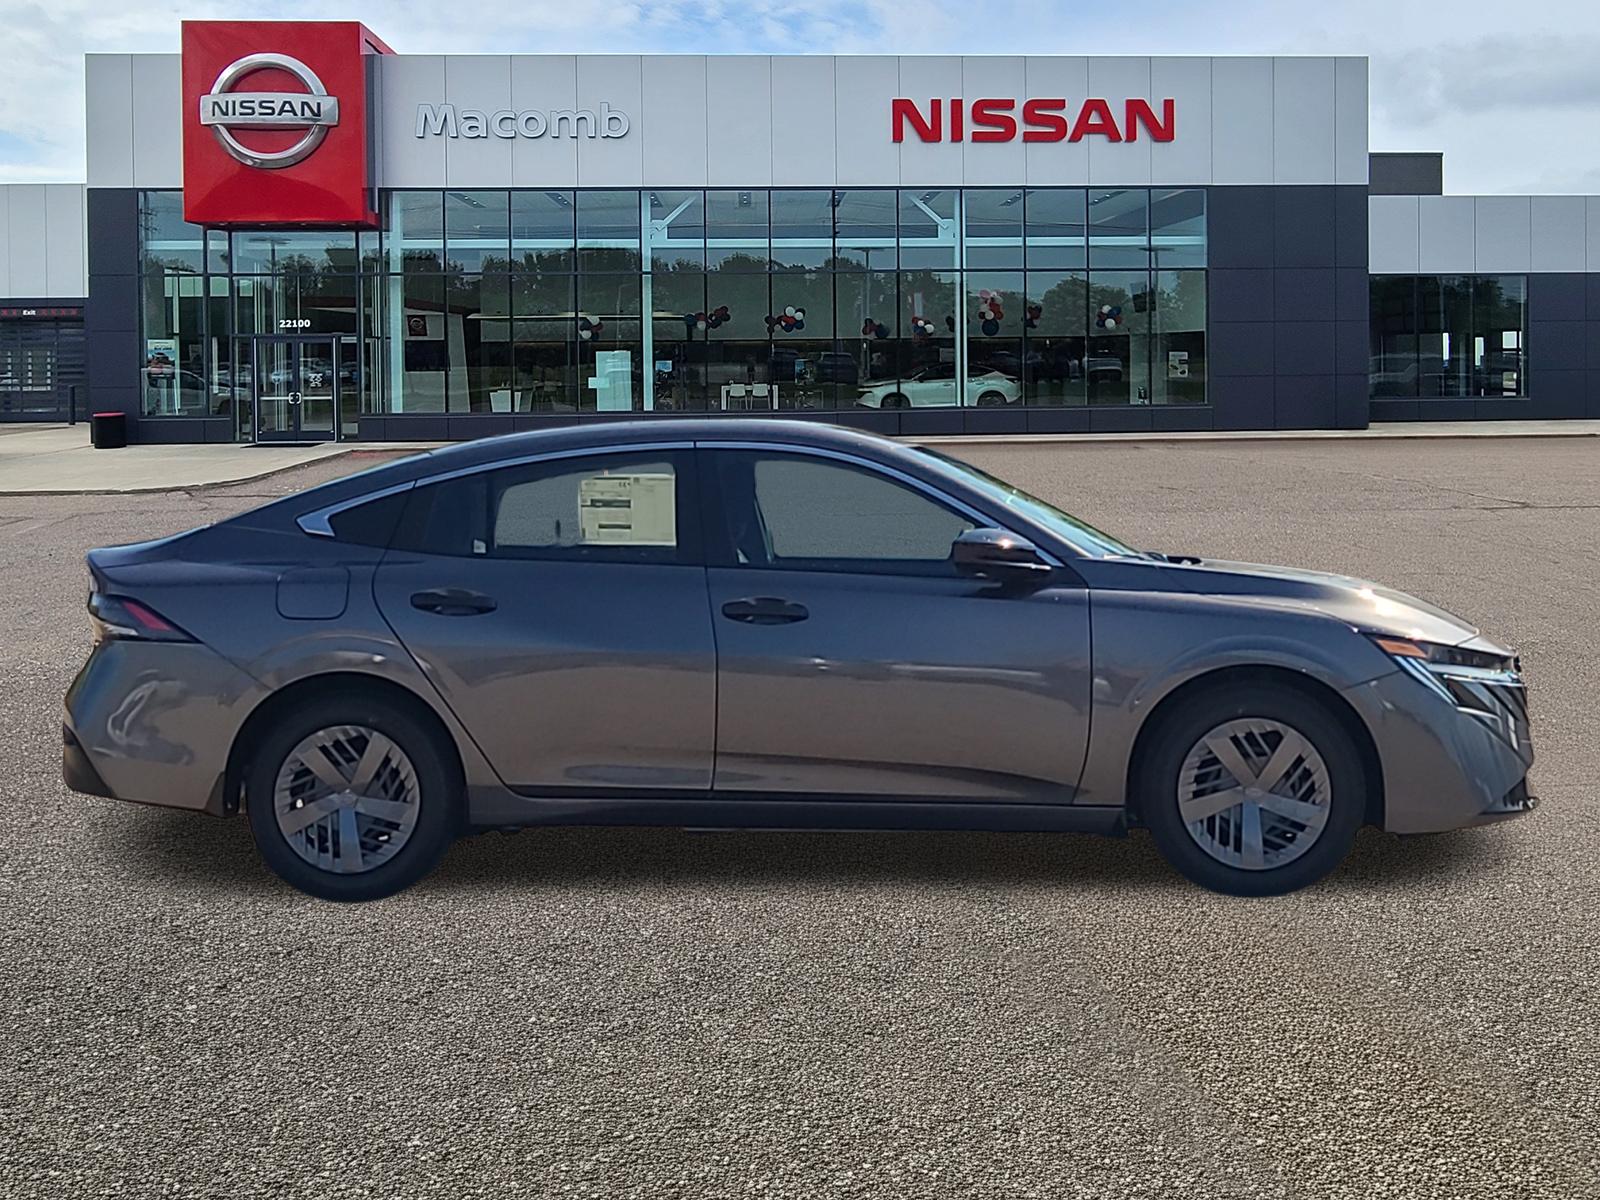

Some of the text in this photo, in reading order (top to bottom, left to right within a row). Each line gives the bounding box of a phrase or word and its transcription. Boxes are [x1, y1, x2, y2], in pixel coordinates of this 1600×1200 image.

[212, 100, 321, 117] NISSAN
[415, 102, 630, 138] Macomb
[892, 98, 1175, 142] NISSAN
[279, 319, 311, 328] 22100
